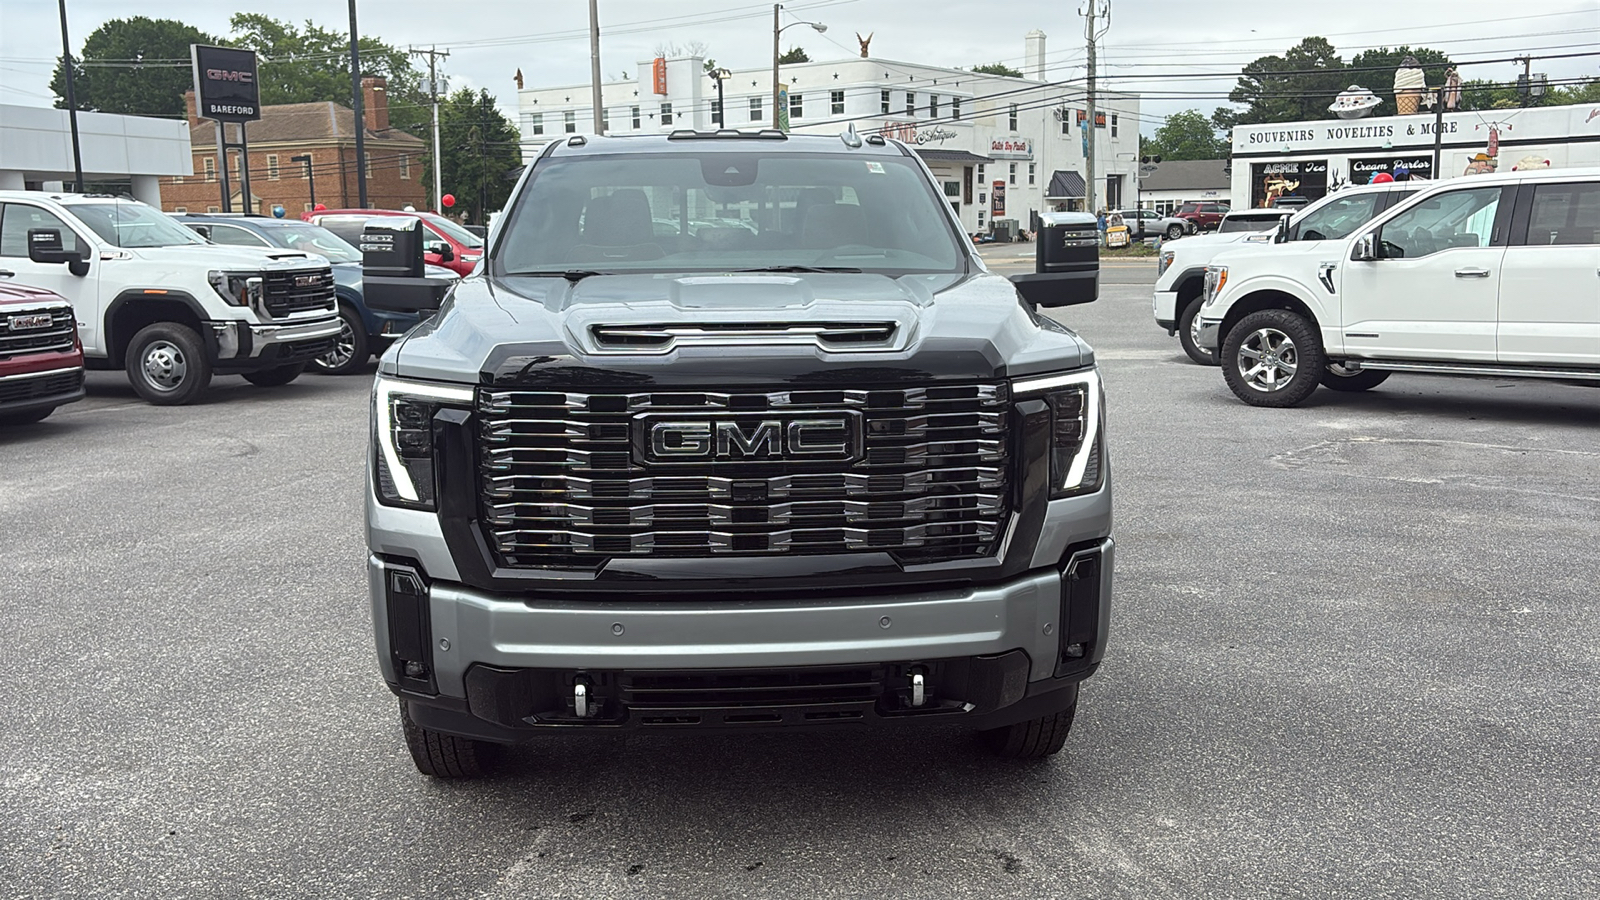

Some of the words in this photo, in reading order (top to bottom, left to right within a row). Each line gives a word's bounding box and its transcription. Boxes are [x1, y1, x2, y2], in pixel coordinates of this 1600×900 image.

[207, 69, 252, 82] GMC
[210, 104, 254, 115] BAREFORD
[880, 121, 917, 144] ACME
[1249, 129, 1315, 144] SOUVENIRS
[1327, 125, 1394, 140] NOVELTIES
[1406, 124, 1416, 136] &
[1420, 121, 1458, 135] MORE
[1263, 163, 1299, 174] ACME
[1305, 162, 1327, 173] Ice
[1353, 161, 1388, 171] Cream
[1393, 159, 1431, 170] Parlor
[651, 419, 847, 457] GMC
